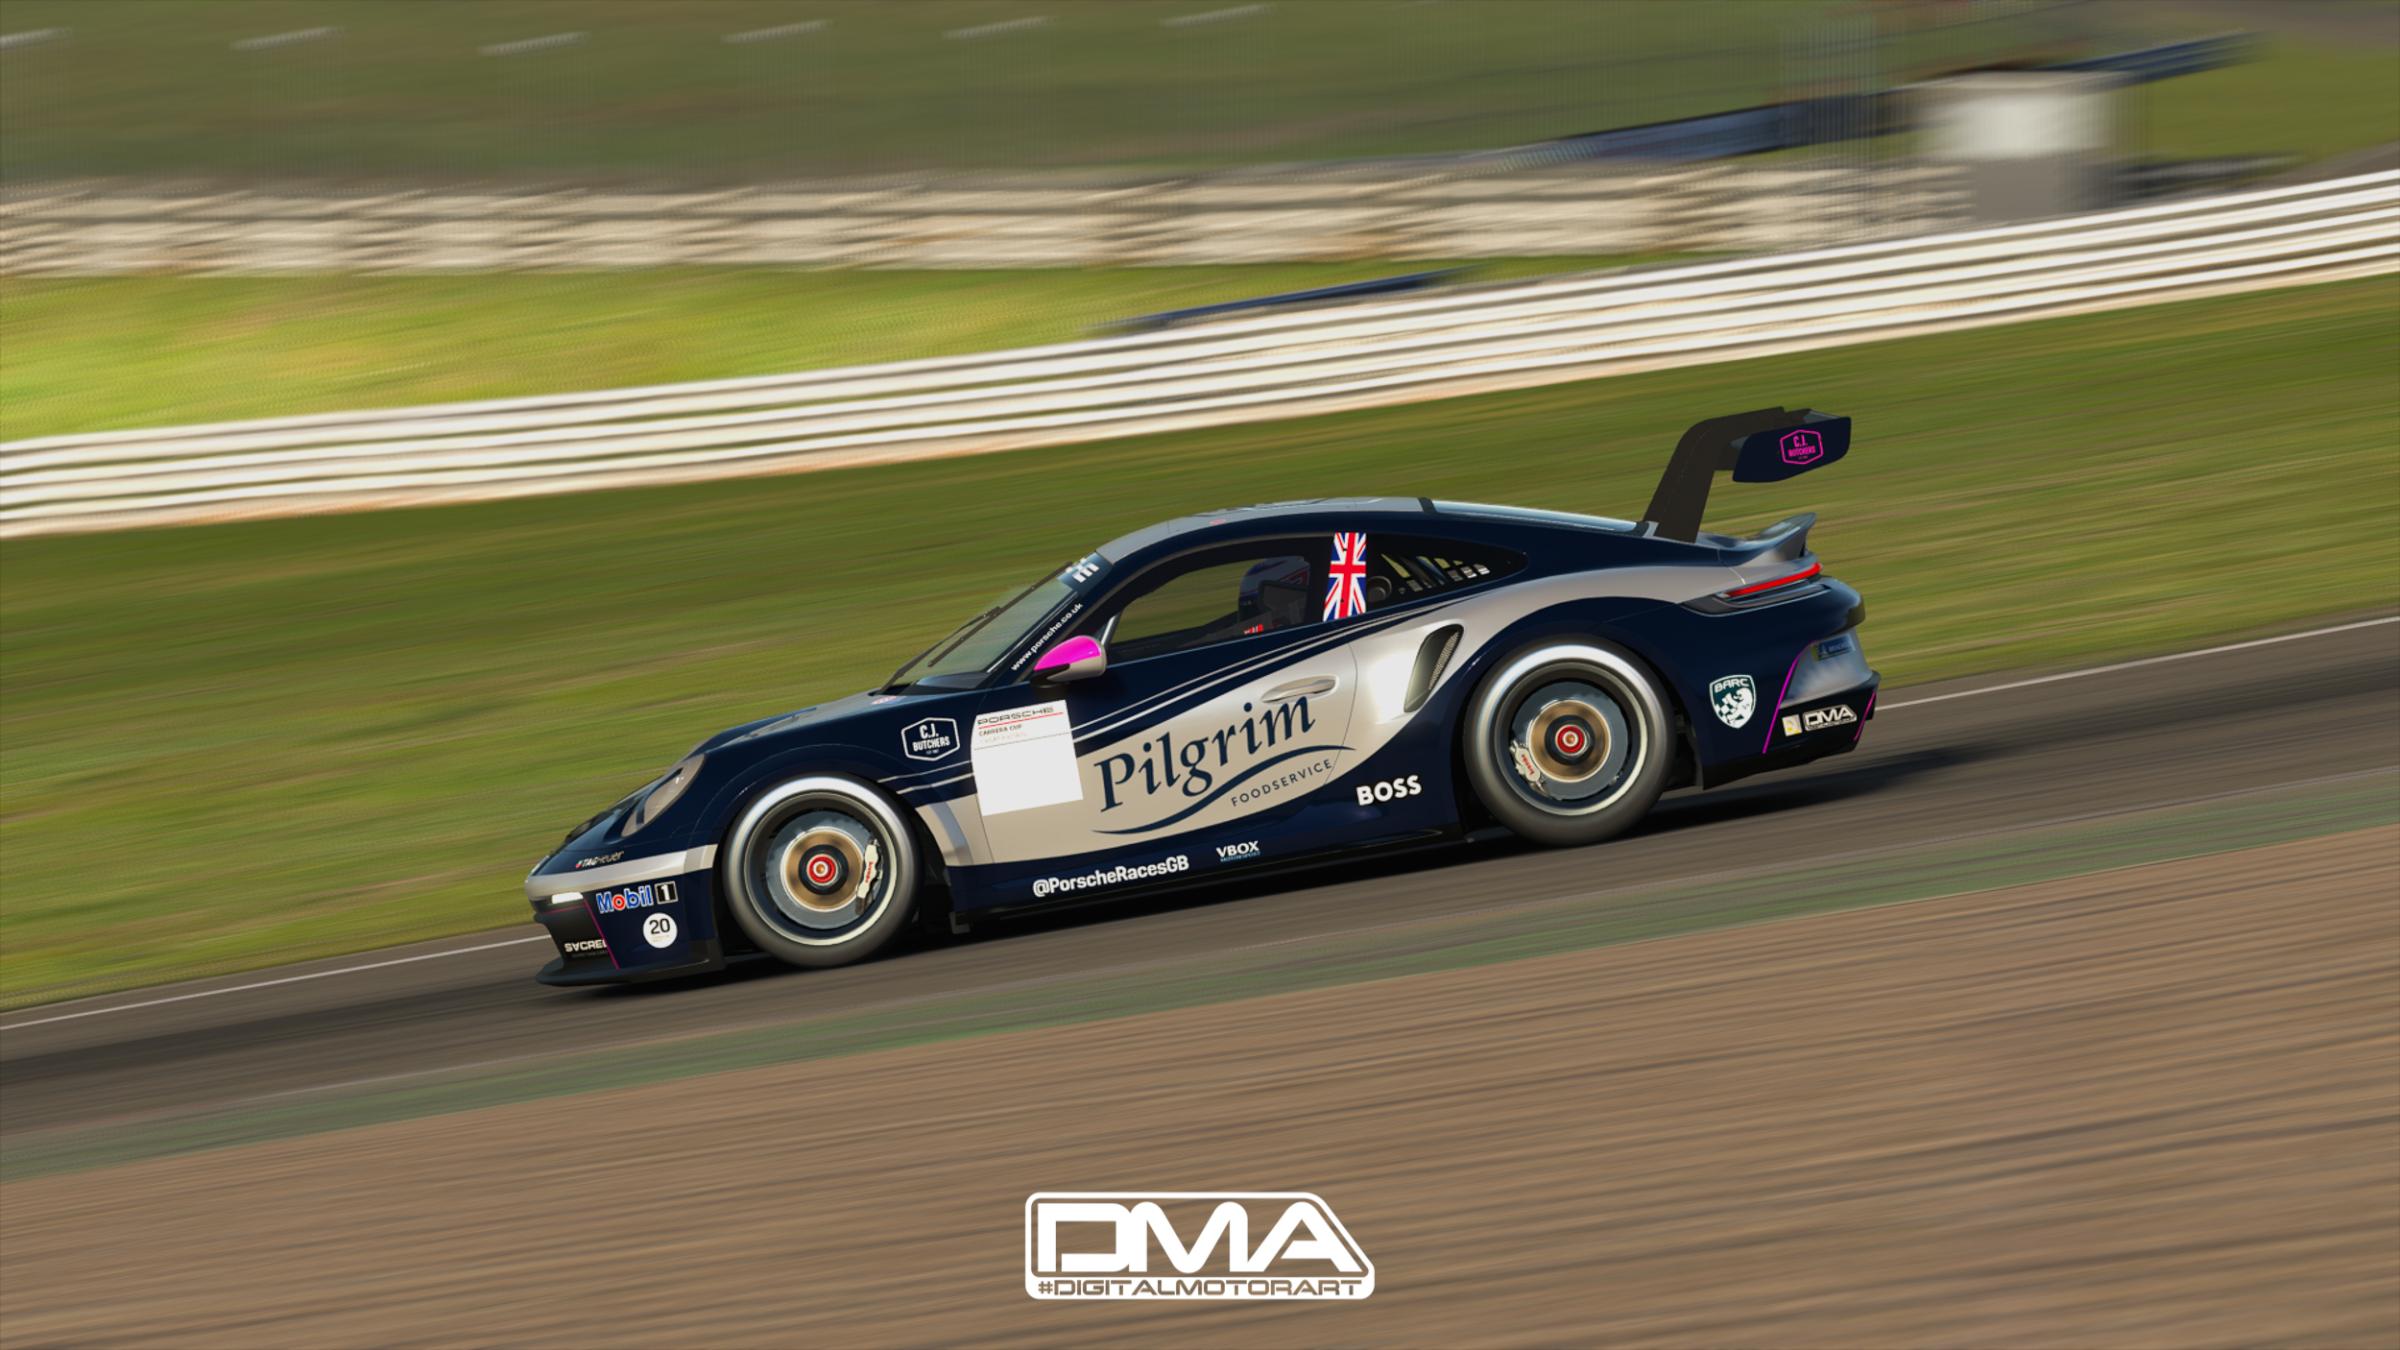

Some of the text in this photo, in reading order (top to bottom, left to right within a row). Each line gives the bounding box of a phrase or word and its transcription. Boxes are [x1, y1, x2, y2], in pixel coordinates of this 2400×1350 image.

[1011, 603, 1083, 671] www.porsche.co.uk
[1713, 678, 1750, 693] BARC
[977, 706, 1055, 725] PORSCHE
[1805, 707, 1853, 726] DMA
[919, 723, 939, 739] C.J.
[912, 736, 950, 752] BUTCHERS
[1093, 695, 1316, 812] Pilgrim
[1231, 758, 1333, 807] FOODSERVICE
[1356, 775, 1423, 806] BOSS
[1216, 840, 1260, 858] VBOX
[1032, 854, 1190, 898] @PorscheRacesGB
[596, 885, 653, 914] Mobil
[649, 918, 671, 935] 20
